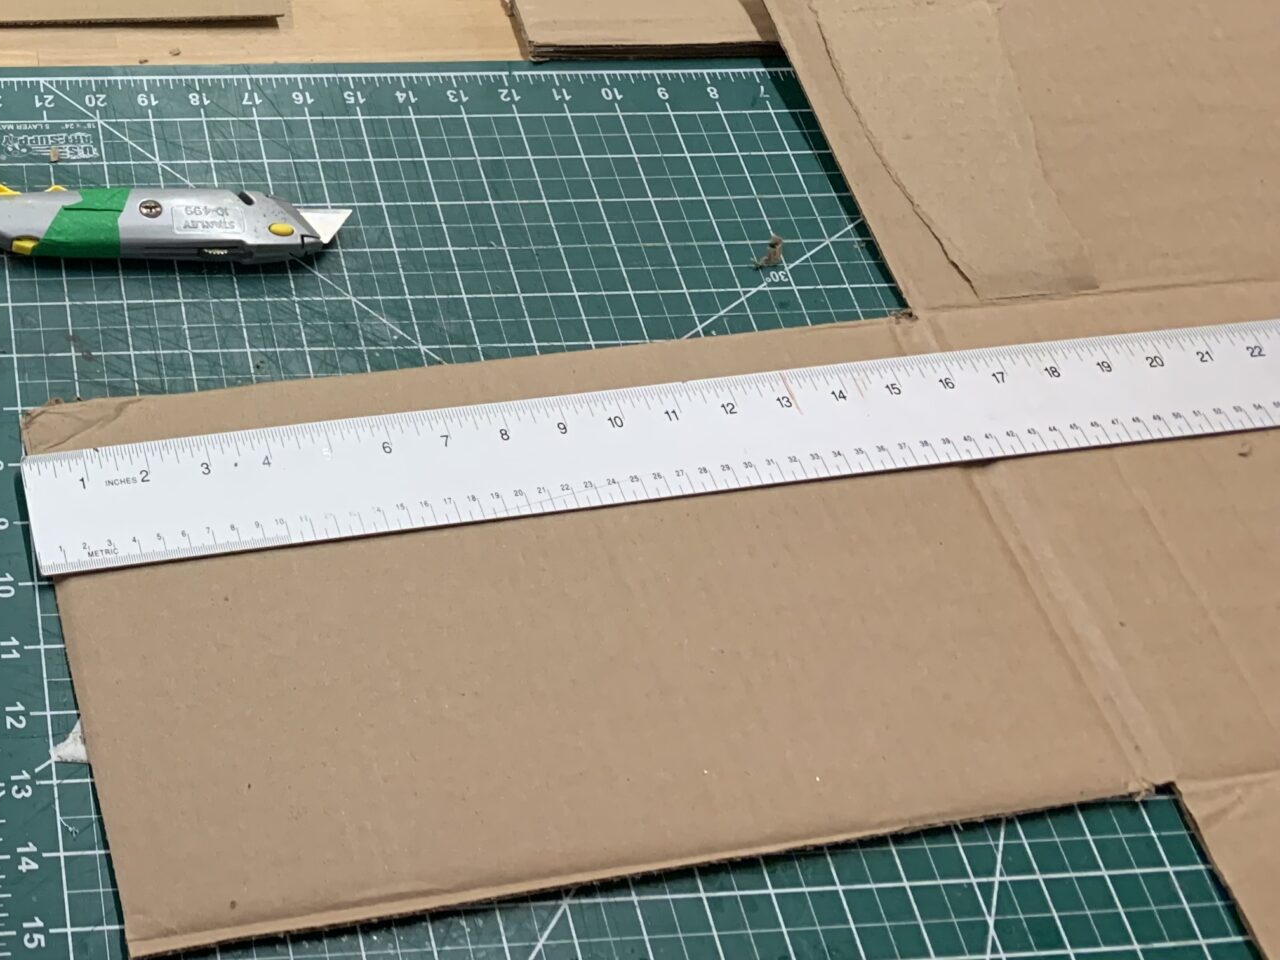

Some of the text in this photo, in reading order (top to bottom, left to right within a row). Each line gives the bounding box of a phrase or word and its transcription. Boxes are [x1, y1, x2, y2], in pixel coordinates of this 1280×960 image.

[34, 94, 55, 107] 21
[85, 94, 107, 107] 20
[137, 93, 159, 107] 19
[190, 93, 211, 106] 18
[242, 92, 263, 105] 17
[294, 92, 315, 105] 16
[343, 91, 366, 105] 15
[395, 90, 418, 104] 14
[446, 90, 469, 103] 13
[499, 89, 522, 102] 12
[551, 88, 572, 102] 11
[601, 87, 624, 101] 10
[657, 87, 670, 100] 9
[707, 86, 720, 99] 8
[757, 86, 770, 99] 7
[183, 220, 236, 229] STANLEY
[184, 206, 229, 217] 10-499
[79, 478, 87, 490] 1
[105, 476, 137, 487] INCHES
[139, 470, 150, 483] 2
[201, 462, 211, 475] 3
[262, 455, 271, 467] 4
[382, 441, 392, 454] 6
[440, 434, 449, 447] 7
[499, 428, 510, 441] 8
[557, 422, 567, 435] 9
[607, 415, 624, 429] 10
[664, 409, 679, 422] 11
[720, 402, 737, 415] 12
[776, 396, 793, 409] 13
[830, 390, 847, 402] 14
[885, 383, 902, 396] 15
[938, 377, 955, 390] 16
[992, 371, 1006, 384] 17
[1044, 366, 1061, 379] 18
[1096, 360, 1112, 373] 19
[1146, 355, 1165, 368] 20
[1196, 350, 1214, 363] 21
[1246, 345, 1265, 358] 22
[59, 545, 64, 553] 1
[82, 542, 89, 550] 2
[106, 539, 113, 547] 3
[131, 536, 138, 544] 4
[230, 523, 236, 531] 8
[274, 517, 285, 526] 10
[395, 503, 406, 511] 15
[419, 500, 430, 508] 16
[443, 497, 452, 505] 17
[467, 494, 477, 502] 18
[490, 491, 500, 499] 19
[513, 489, 524, 497] 20
[537, 486, 546, 494] 21
[560, 483, 570, 491] 22
[583, 480, 593, 489] 23
[606, 477, 617, 486] 24
[629, 475, 640, 483] 25
[652, 472, 662, 480] 26
[675, 469, 684, 477] 27
[698, 466, 708, 474] 28
[720, 464, 731, 472] 29
[743, 461, 753, 469] 30
[765, 458, 774, 466] 31
[788, 455, 798, 463] 32
[810, 453, 820, 461] 33
[832, 450, 842, 458] 34
[854, 447, 865, 455] 35
[876, 445, 886, 453] 36
[898, 442, 907, 450] 37
[919, 440, 930, 448] 38
[87, 547, 119, 558] METRIC
[0, 637, 21, 659] 11
[5, 701, 27, 730] 12
[10, 769, 32, 799] 13
[16, 841, 39, 873] 14
[22, 916, 45, 949] 15
